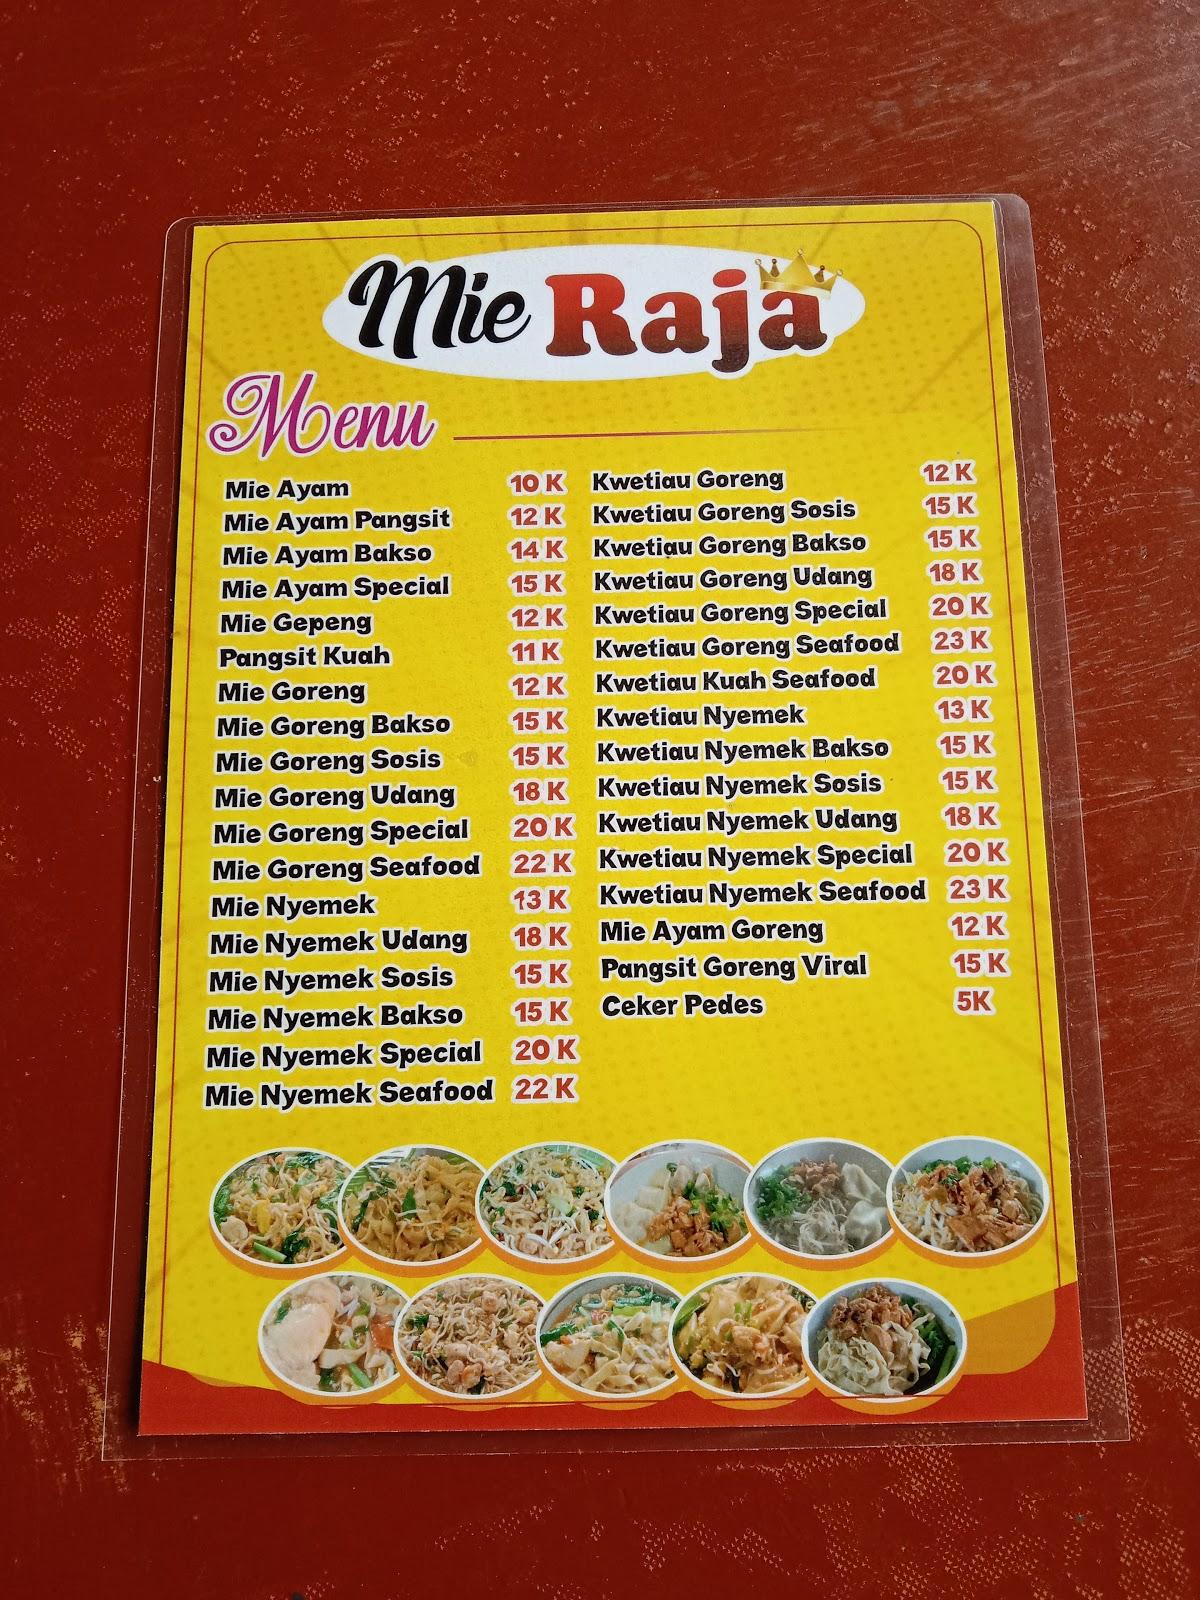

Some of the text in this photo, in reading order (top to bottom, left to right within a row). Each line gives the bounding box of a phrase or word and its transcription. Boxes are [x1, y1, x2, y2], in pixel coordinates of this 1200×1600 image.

[348, 261, 827, 372] Mie Raja
[209, 373, 434, 457] Menu
[511, 474, 561, 493] 10 K
[592, 469, 784, 491] Kwetiau Goreng
[923, 463, 972, 482] 12 K
[225, 479, 349, 502] Mie Ayam
[511, 507, 561, 526] 12 K
[593, 499, 856, 524] Kwetiau Goreng Sosis
[927, 496, 972, 515] 15 K
[224, 509, 450, 535] Mie Ayam Pangsit
[512, 540, 562, 560] 14 K
[594, 532, 866, 558] Kwetiau Goreng Bakso
[929, 529, 976, 549] 15 K
[223, 543, 432, 569] Mie Ayam Bakso
[222, 576, 449, 602] Mie Ayam Special
[594, 566, 873, 592] Kwetiau Goreng Udang
[513, 607, 562, 627] 12 K
[595, 598, 887, 625] Kwetiau Goreng Special
[933, 596, 987, 616] 20 K
[220, 612, 372, 636] Mie Gepeng
[514, 642, 559, 662] 11 K
[596, 632, 900, 659] Kwetiau Goreng Seafood
[935, 631, 987, 651] 23 K
[220, 645, 390, 671] Pangsit Kuah
[513, 676, 563, 696] 12 K
[596, 667, 876, 693] Kwetiau Kuah Seafood
[938, 665, 991, 685] 20 K
[218, 681, 365, 704] Mie Goreng
[513, 711, 563, 731] 15 K
[597, 704, 805, 730] Kwetiau Nyemek
[938, 699, 987, 720] 13 K
[217, 714, 451, 739] Mie Goreng Bakso
[597, 737, 889, 765] Kwetiau Nyemek Bakso
[940, 735, 989, 755] 15 K
[216, 748, 441, 775] Mie Goreng Sosis
[215, 784, 455, 810] Mie Goreng Udang
[513, 781, 565, 801] 18 K
[598, 772, 882, 800] Kwetiau Nyemek Sosis
[514, 816, 573, 838] 20 K
[599, 808, 898, 836] Kwetiau Nyemek Udang
[945, 806, 995, 826] 18 K
[214, 818, 468, 846] Mie Goreng Special
[514, 853, 571, 874] 22 K
[599, 843, 913, 872] Kwetiau Nyemek Special
[949, 842, 1006, 863] 20 K
[212, 854, 480, 883] Mie Goreng Seafood
[514, 889, 566, 910] 13 K
[600, 879, 926, 908] Kwetiau Nyemek Seafood
[211, 893, 376, 921] Mie Nyemek
[515, 926, 567, 947] 18 K
[601, 918, 824, 946] Mie Ayam Goreng
[952, 915, 1003, 937] 12 K
[210, 929, 468, 958] Mie Nyemek Udang
[601, 954, 867, 983] Pangsit Goreng Viral
[955, 953, 1006, 974] 15 K
[209, 966, 453, 996] Mie Nyemek Sosis
[515, 1001, 567, 1023] 15 K
[602, 993, 764, 1017] Ceker Pedes
[958, 991, 990, 1012] 5K
[208, 1004, 463, 1034] Mie Nyemek Bakso
[207, 1040, 481, 1072] Mie Nyemek Special
[205, 1079, 493, 1111] Mie Nyemek Seafood
[515, 1077, 574, 1100] 22 K
